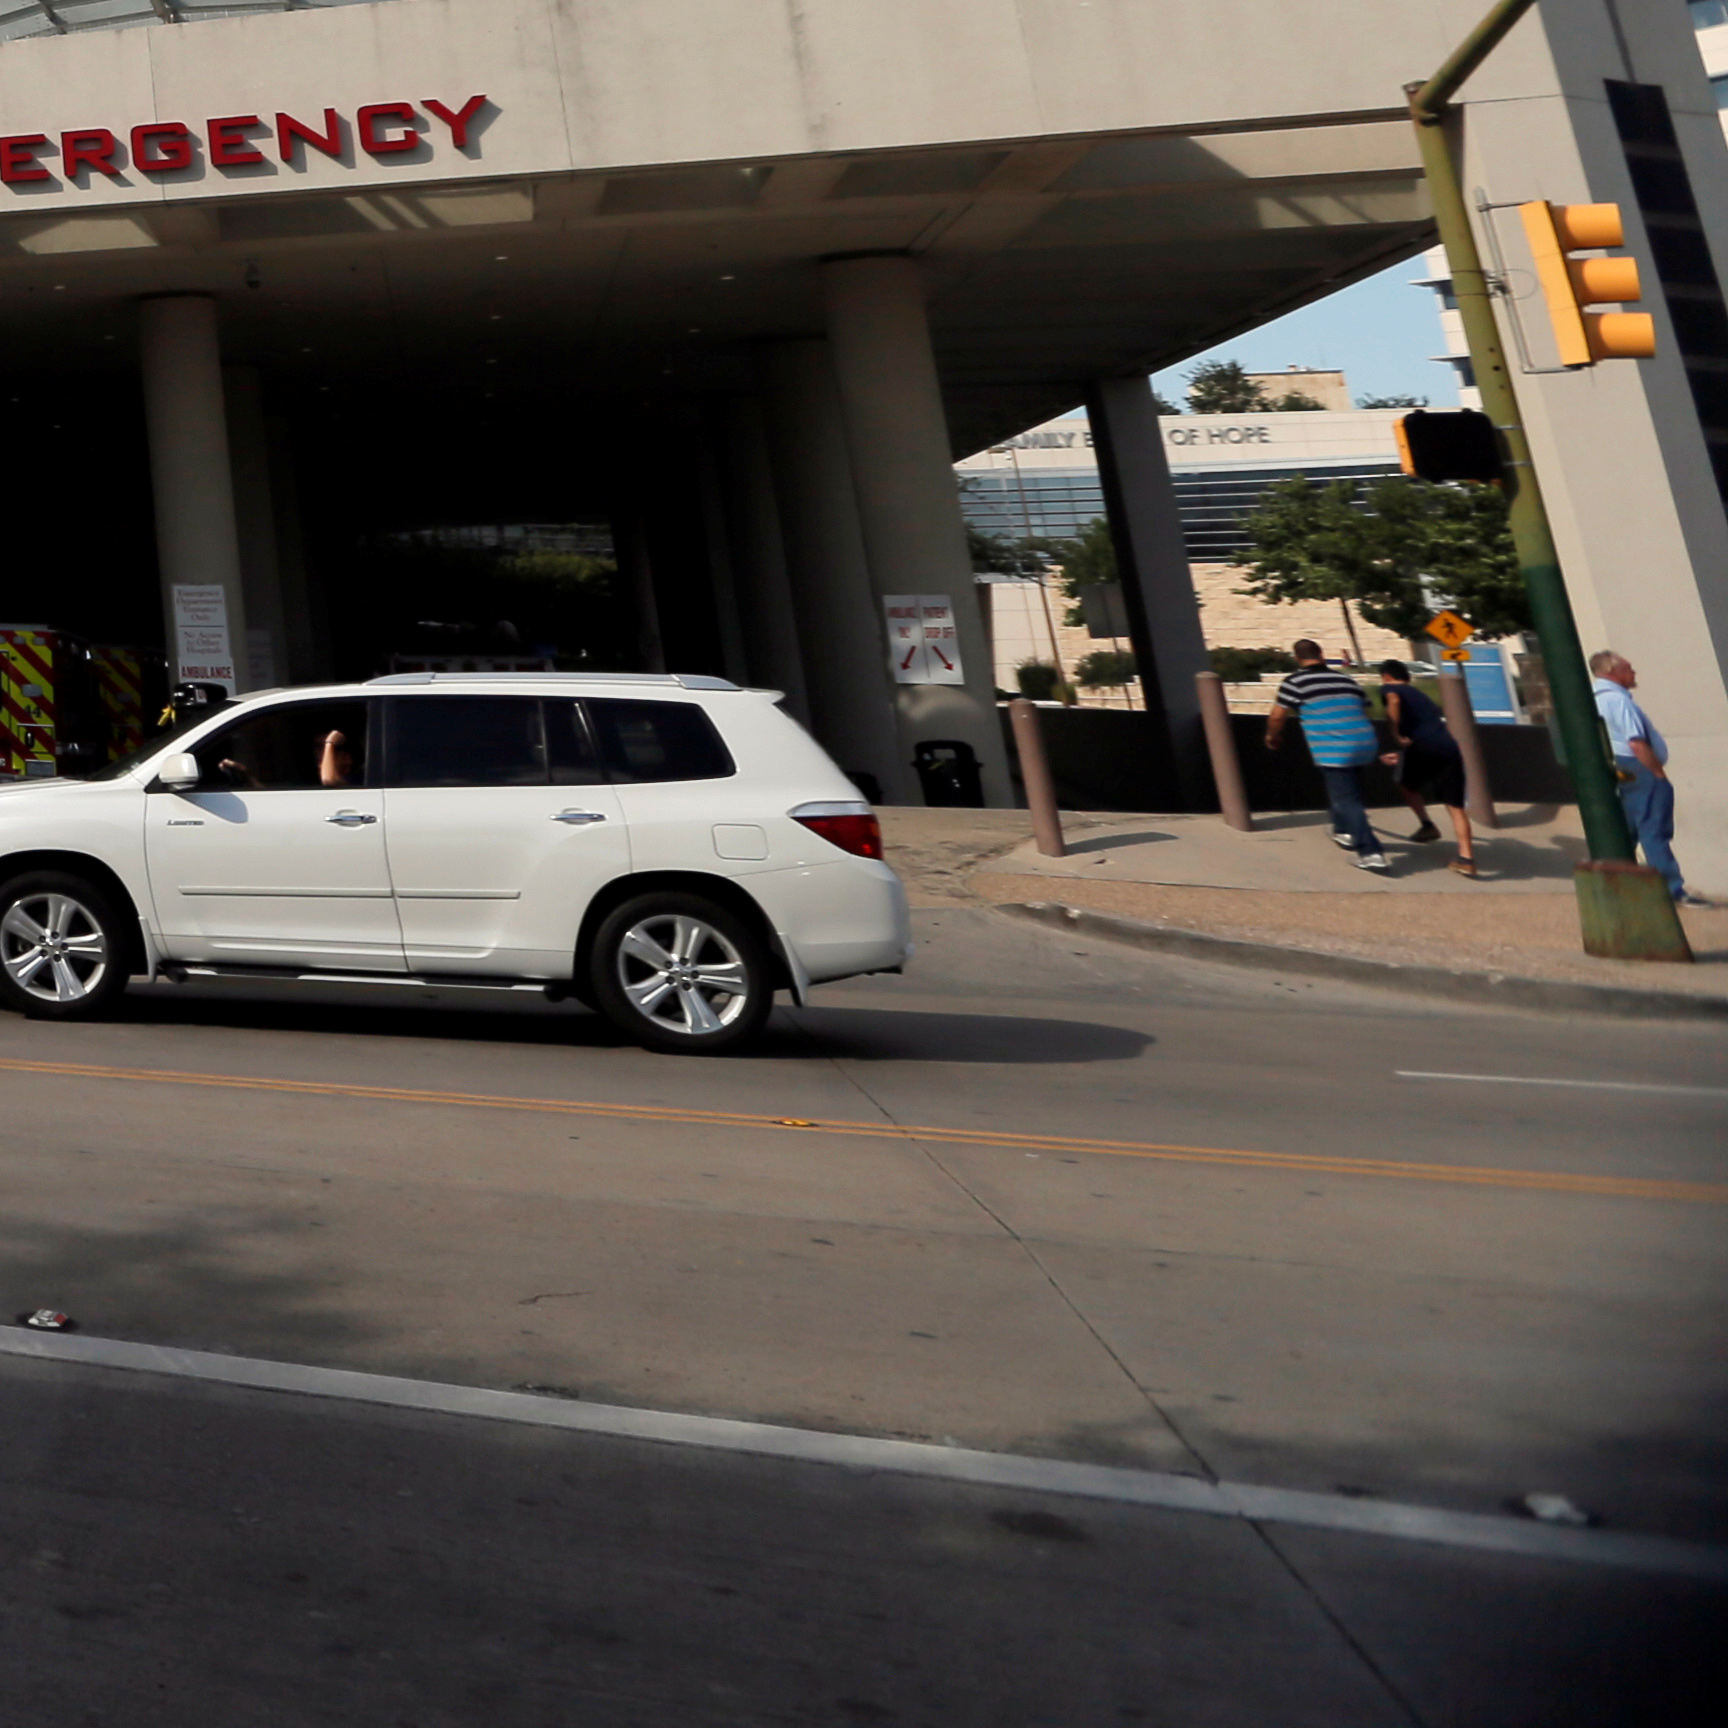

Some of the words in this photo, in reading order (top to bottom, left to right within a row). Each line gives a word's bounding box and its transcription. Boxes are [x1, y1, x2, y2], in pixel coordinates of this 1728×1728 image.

[1001, 432, 1077, 449] AMILY
[1169, 428, 1201, 445] OF
[1207, 426, 1272, 444] HOPE
[181, 665, 233, 680] AMBULANCE
